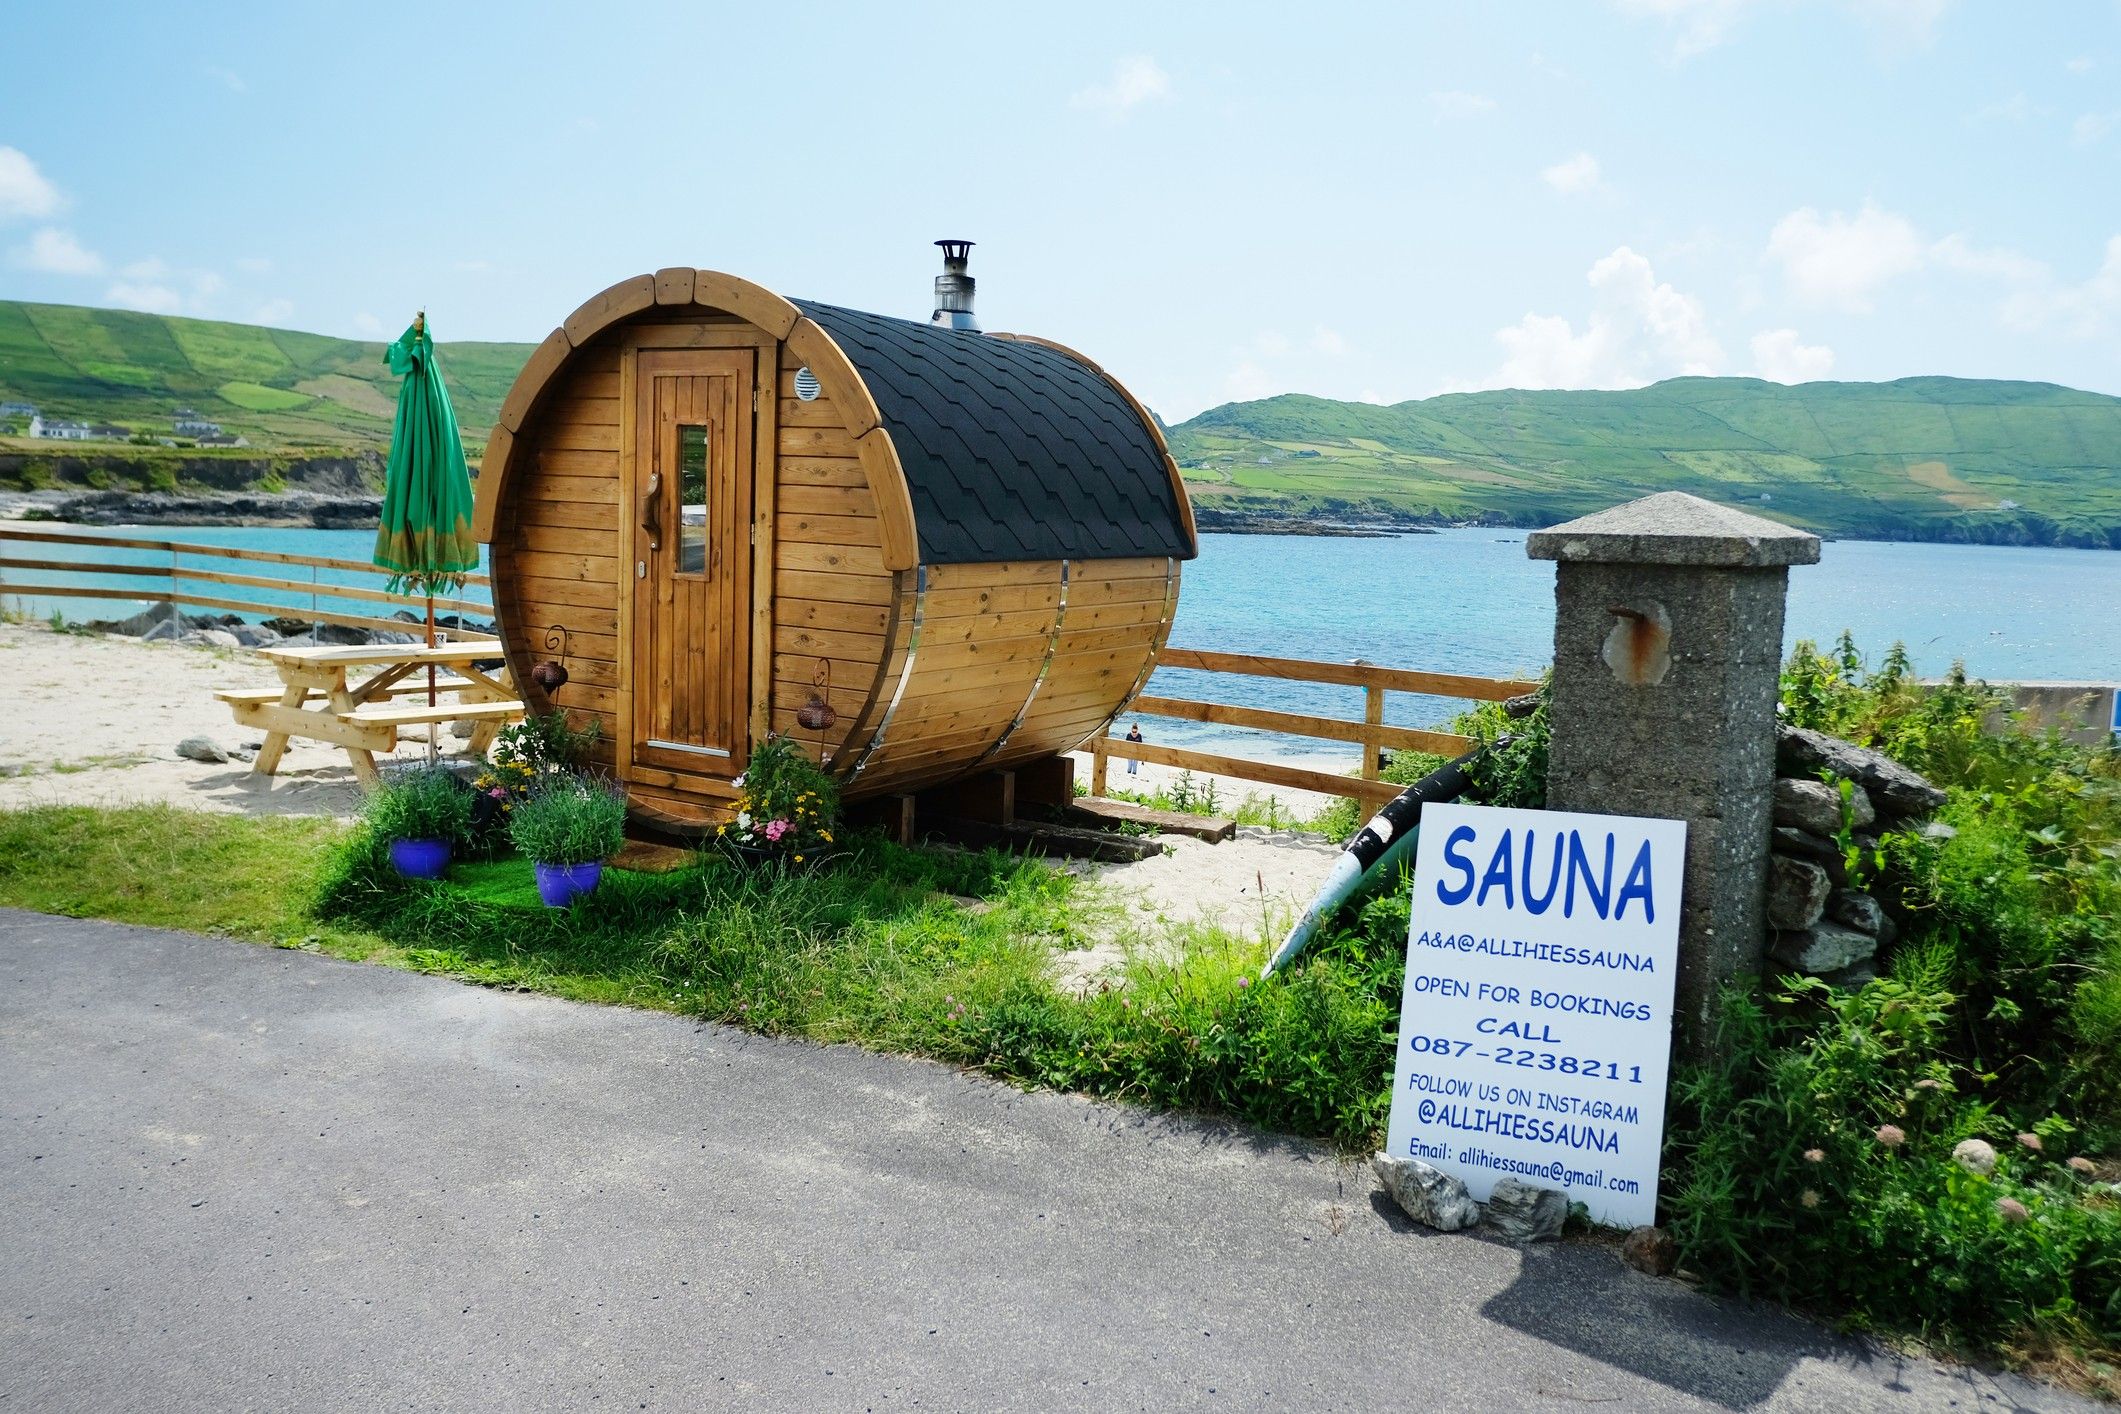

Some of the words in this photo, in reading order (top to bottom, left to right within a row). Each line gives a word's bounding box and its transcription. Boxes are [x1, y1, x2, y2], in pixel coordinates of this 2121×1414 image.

[1436, 824, 1655, 925] SAUNA
[1417, 931, 1654, 973] A&A@ALLIHIESSAUNA
[1414, 975, 1470, 998] OPEN
[1478, 983, 1521, 1004] FOR
[1530, 989, 1652, 1022] BOOKINGS
[1475, 1017, 1562, 1044] CALL
[1410, 1035, 1642, 1084] 087-2238211
[1409, 1073, 1473, 1098] FOLLOW
[1478, 1083, 1500, 1103] US
[1506, 1087, 1532, 1107] ON
[1536, 1092, 1639, 1125] INSTAGRAM
[1417, 1098, 1619, 1155] @ALLIHIESSAUNA
[1409, 1136, 1453, 1160] Email:
[1459, 1146, 1640, 1196] allihiessauna@gmail.com
